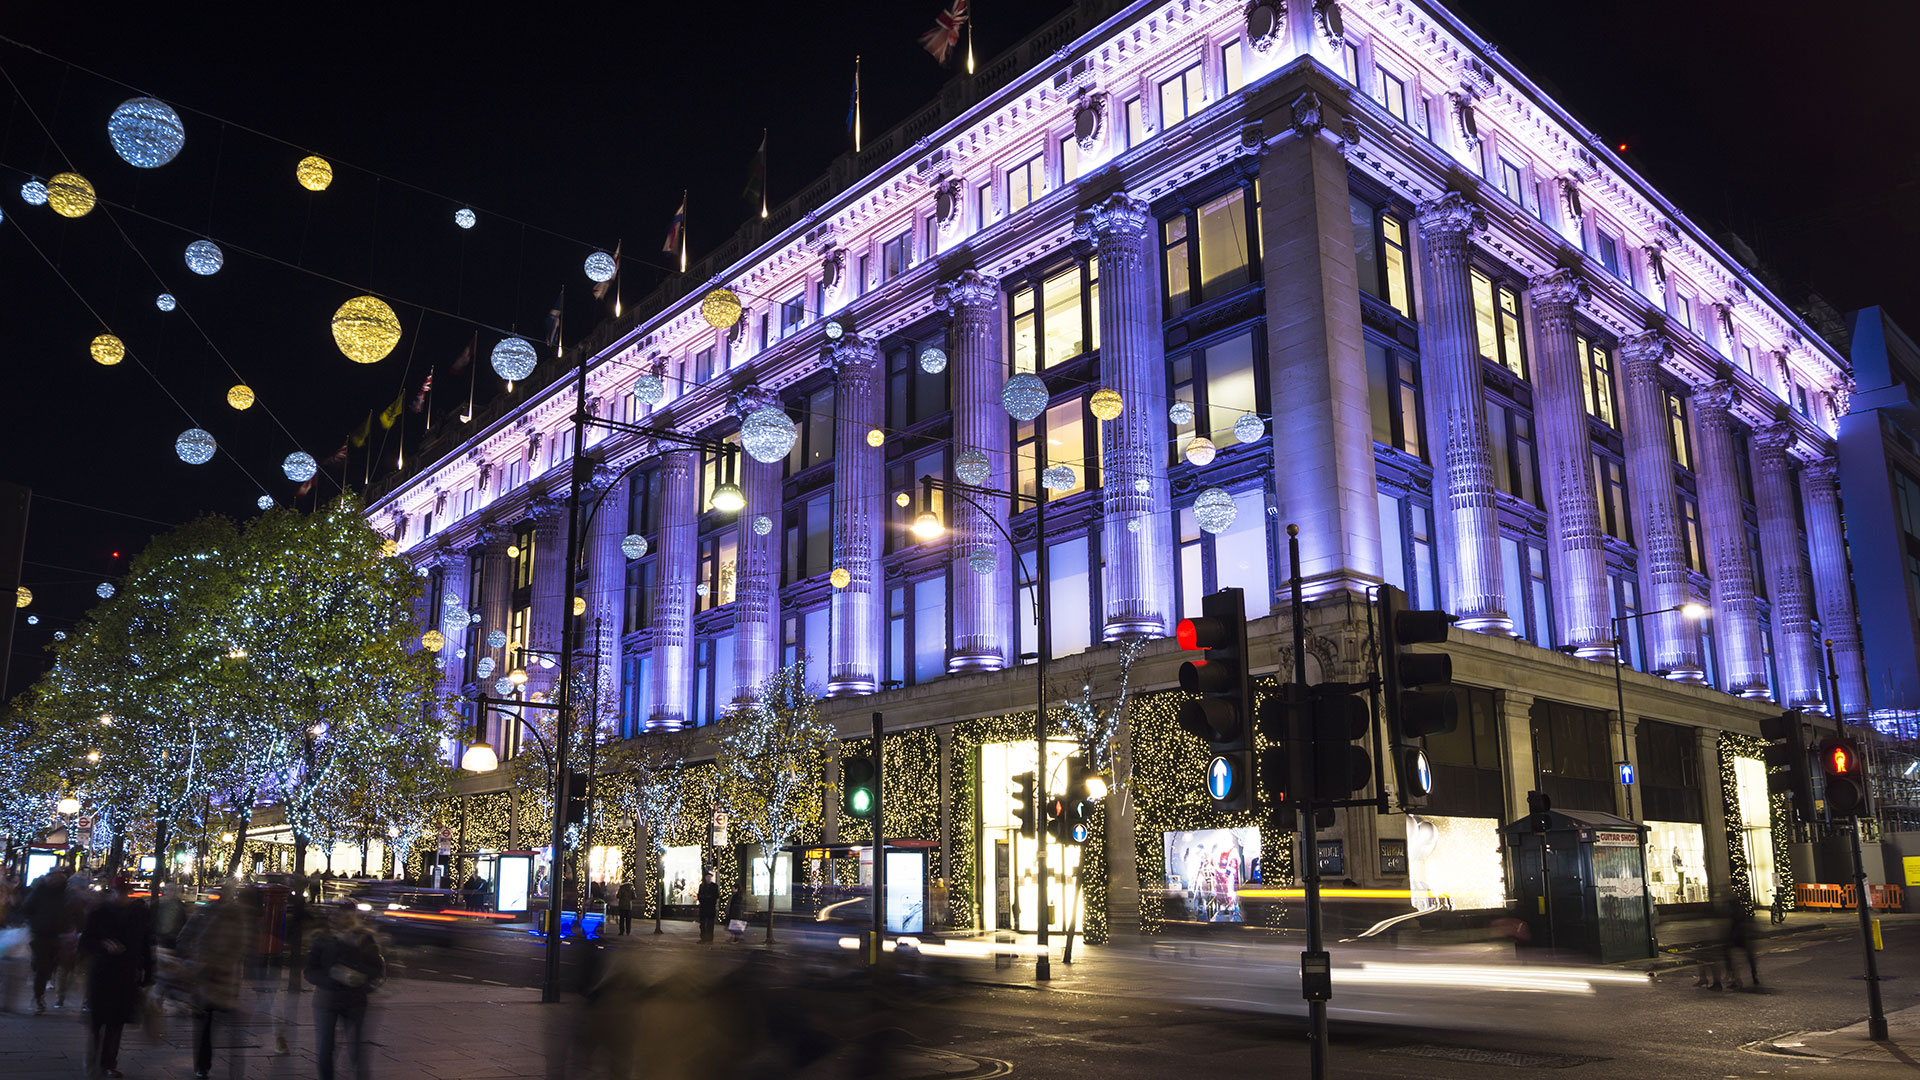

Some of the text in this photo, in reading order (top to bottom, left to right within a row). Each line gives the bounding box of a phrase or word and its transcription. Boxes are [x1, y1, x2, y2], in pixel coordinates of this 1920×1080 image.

[1600, 833, 1635, 842] GUITAR SHOP
[1318, 847, 1340, 858] RIDGE
